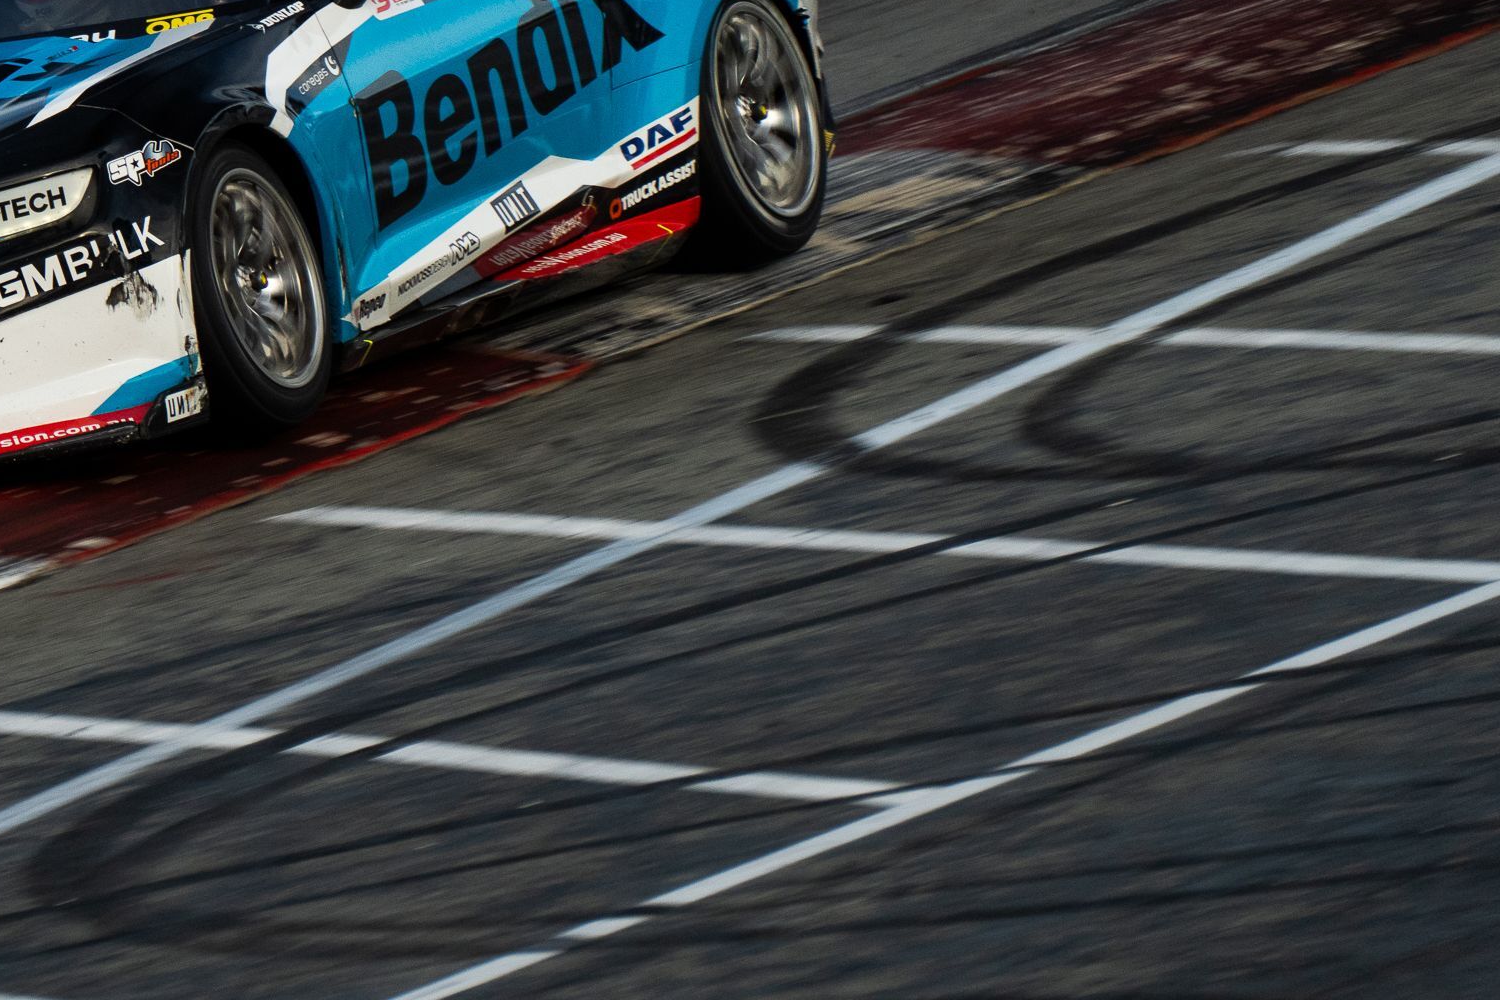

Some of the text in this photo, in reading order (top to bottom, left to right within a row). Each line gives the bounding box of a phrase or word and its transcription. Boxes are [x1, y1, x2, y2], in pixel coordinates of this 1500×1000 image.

[259, 0, 306, 28] DUNLOP
[298, 67, 329, 96] coregas
[619, 106, 693, 162] DAF
[620, 158, 697, 211] TRUCK ASSIST
